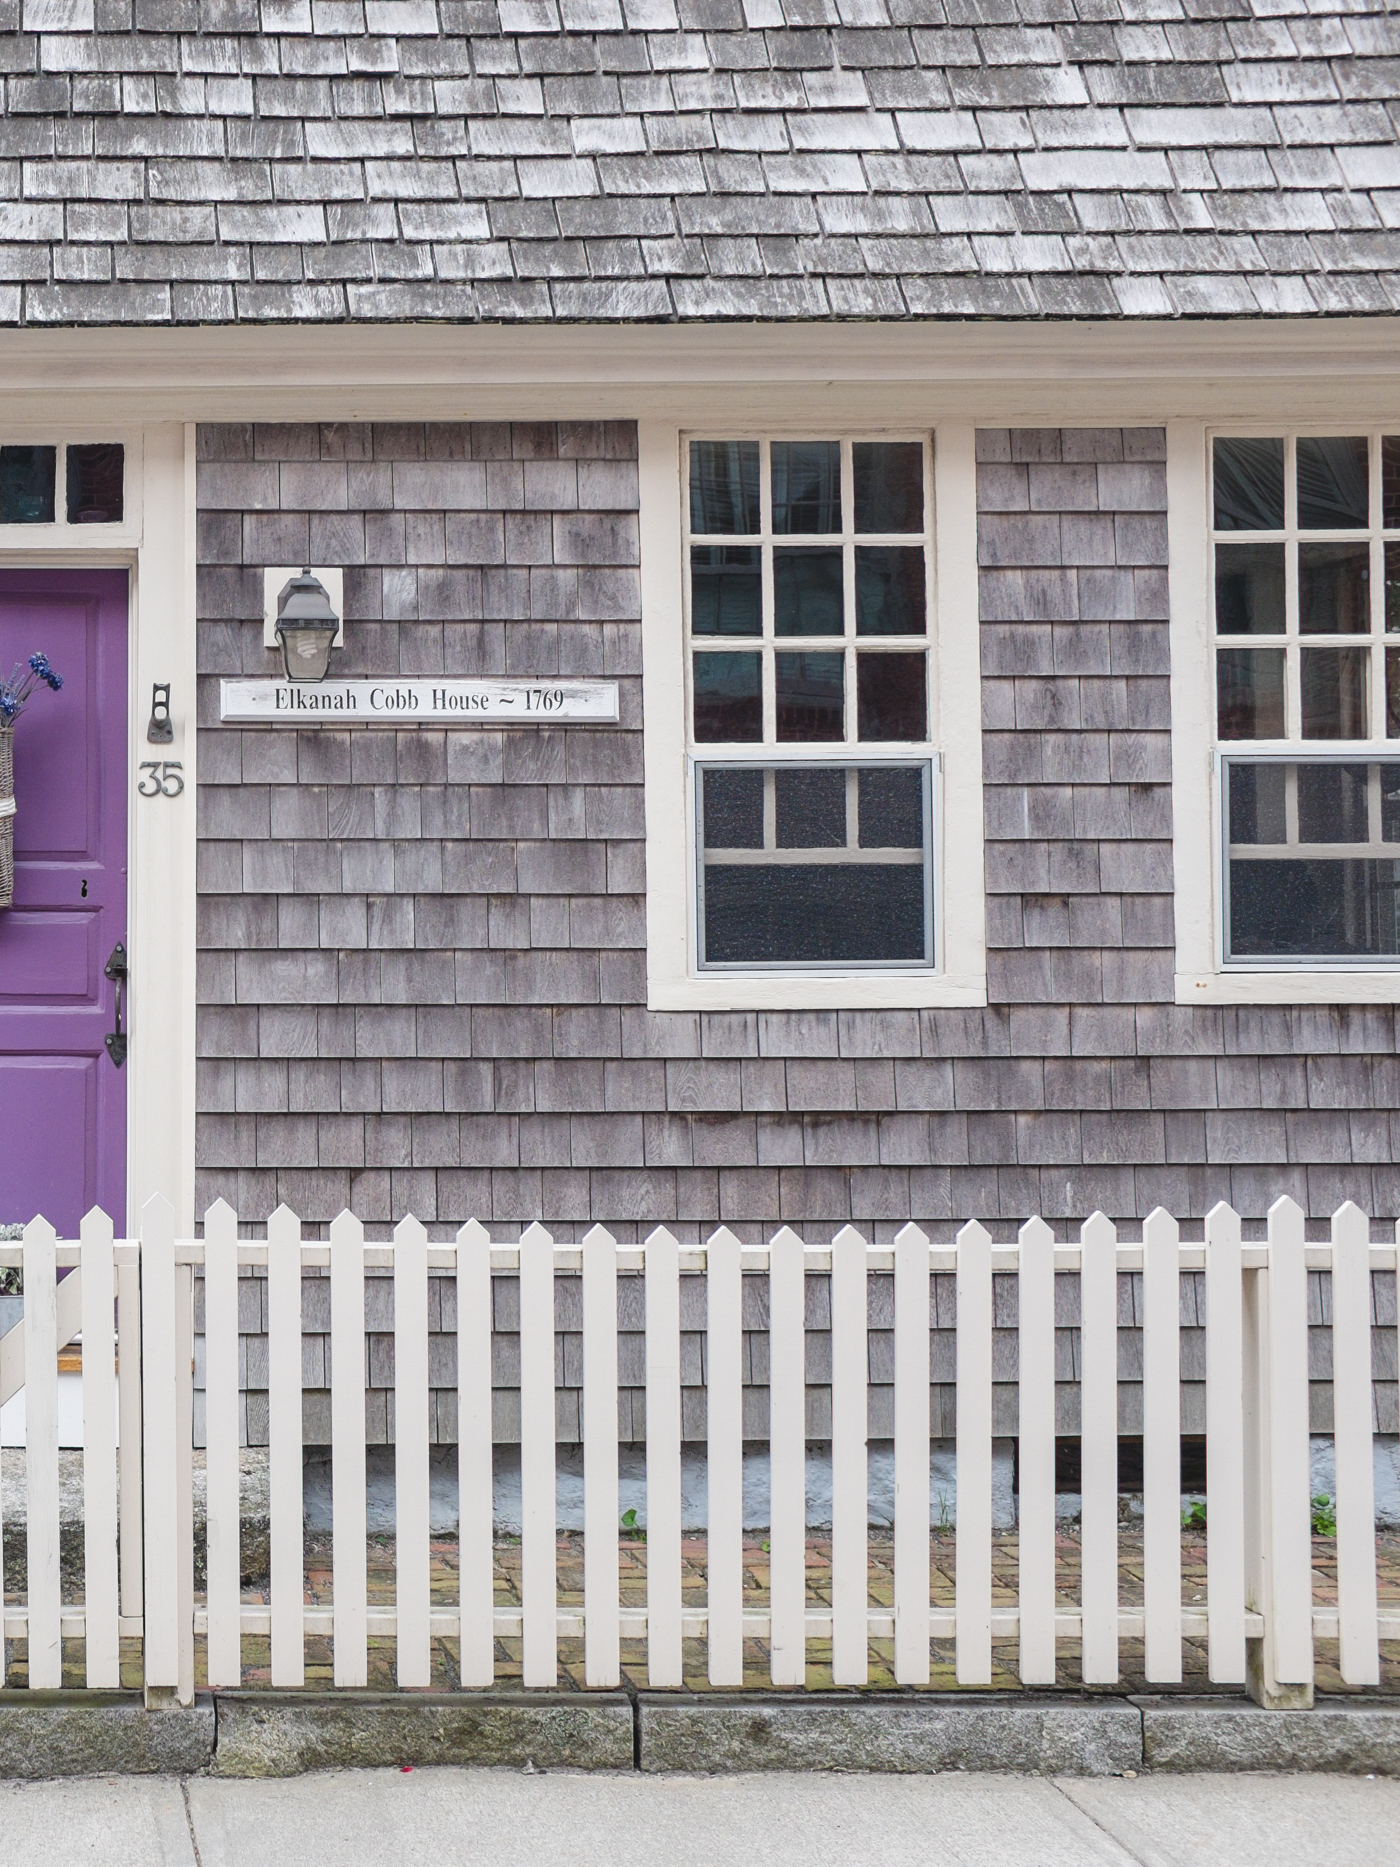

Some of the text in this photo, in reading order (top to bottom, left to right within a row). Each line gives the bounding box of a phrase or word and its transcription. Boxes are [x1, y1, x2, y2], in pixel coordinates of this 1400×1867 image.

[274, 688, 357, 711] Elkanah
[370, 688, 419, 711] Cobb
[431, 688, 489, 711] House
[524, 688, 564, 711] 1769
[138, 761, 184, 797] 35
